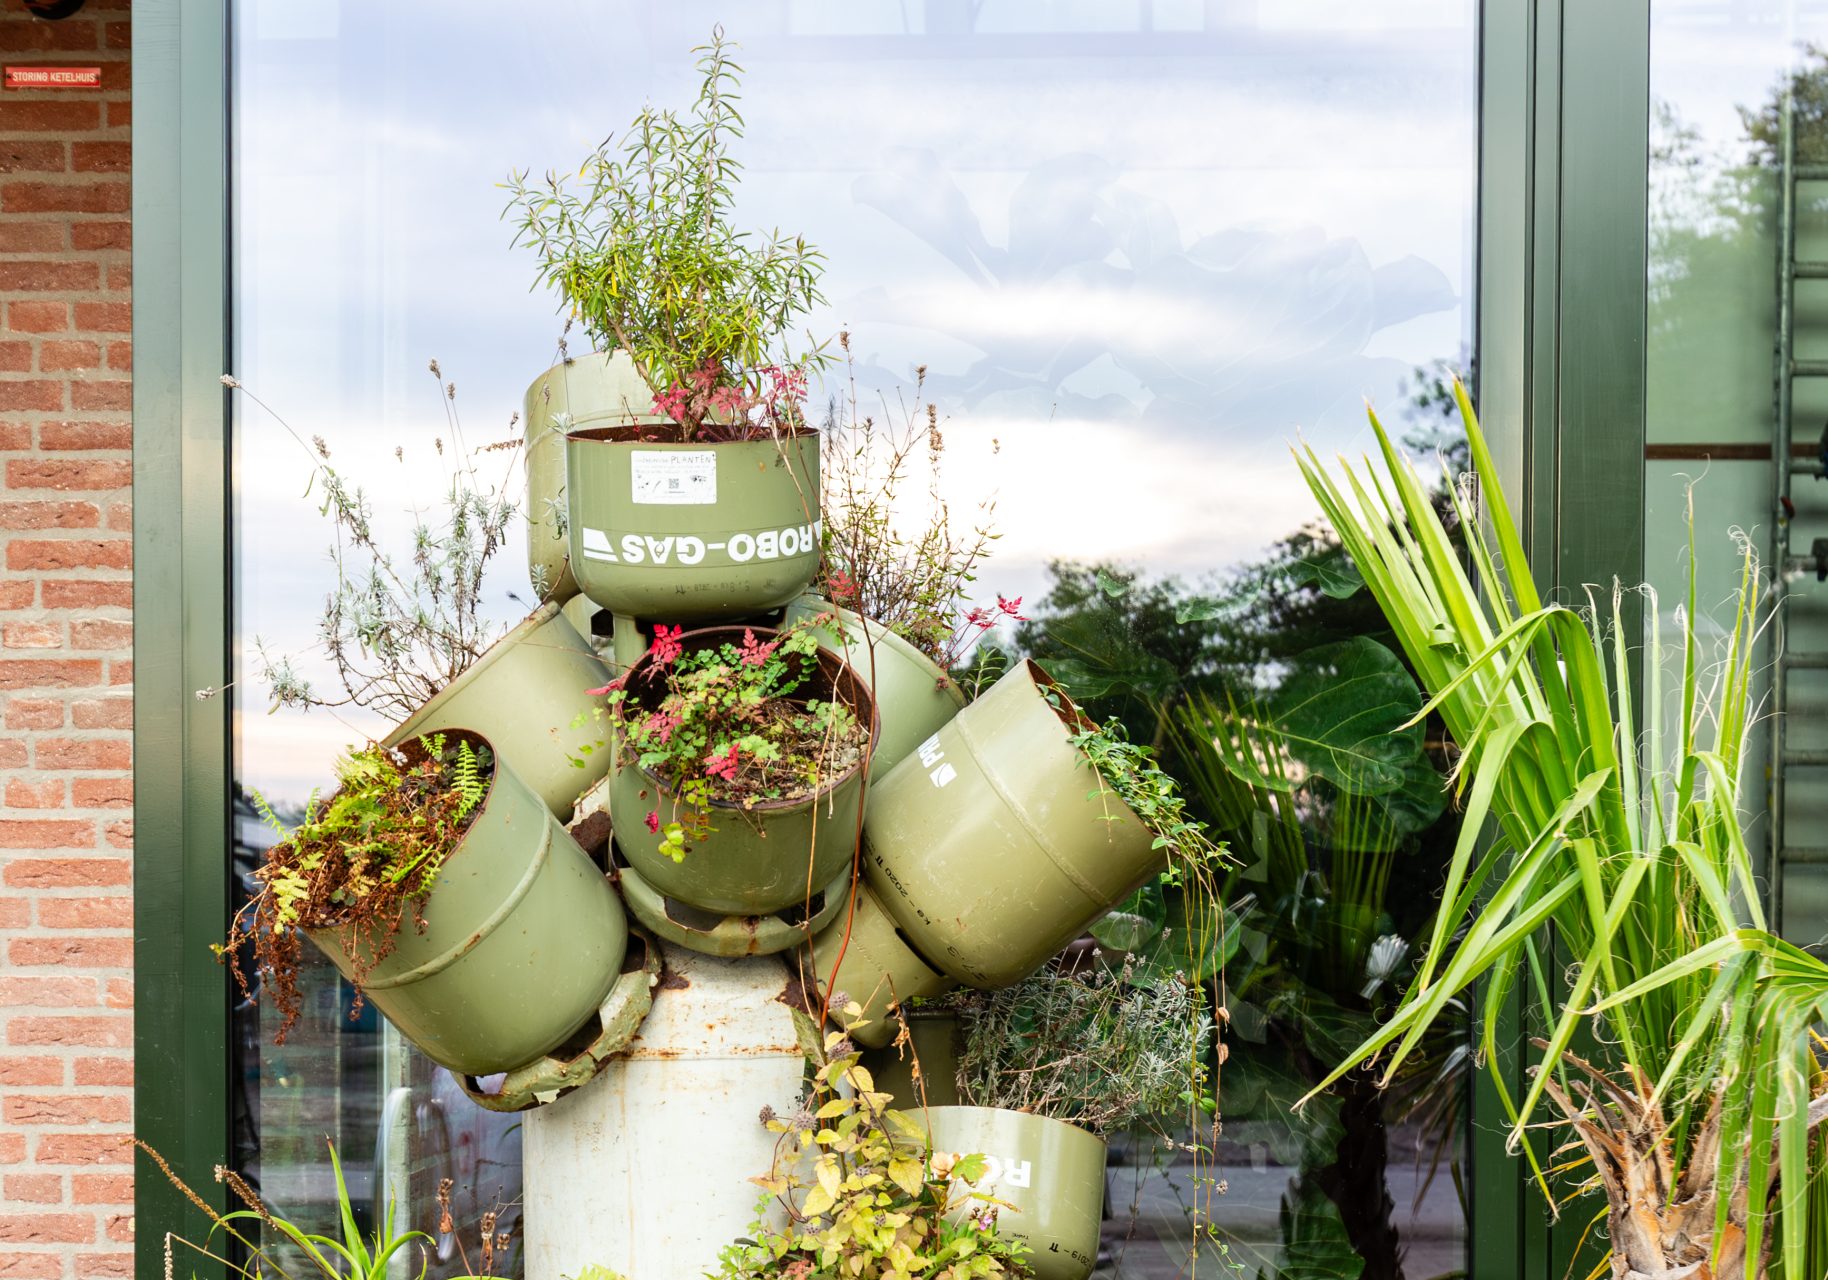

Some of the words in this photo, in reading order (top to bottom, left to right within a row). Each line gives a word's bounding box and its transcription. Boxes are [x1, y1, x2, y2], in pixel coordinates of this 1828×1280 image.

[12, 71, 48, 82] STORING
[50, 72, 96, 82] KETELHUIS
[885, 867, 909, 898] 2020
[1071, 1250, 1091, 1267] 2019
